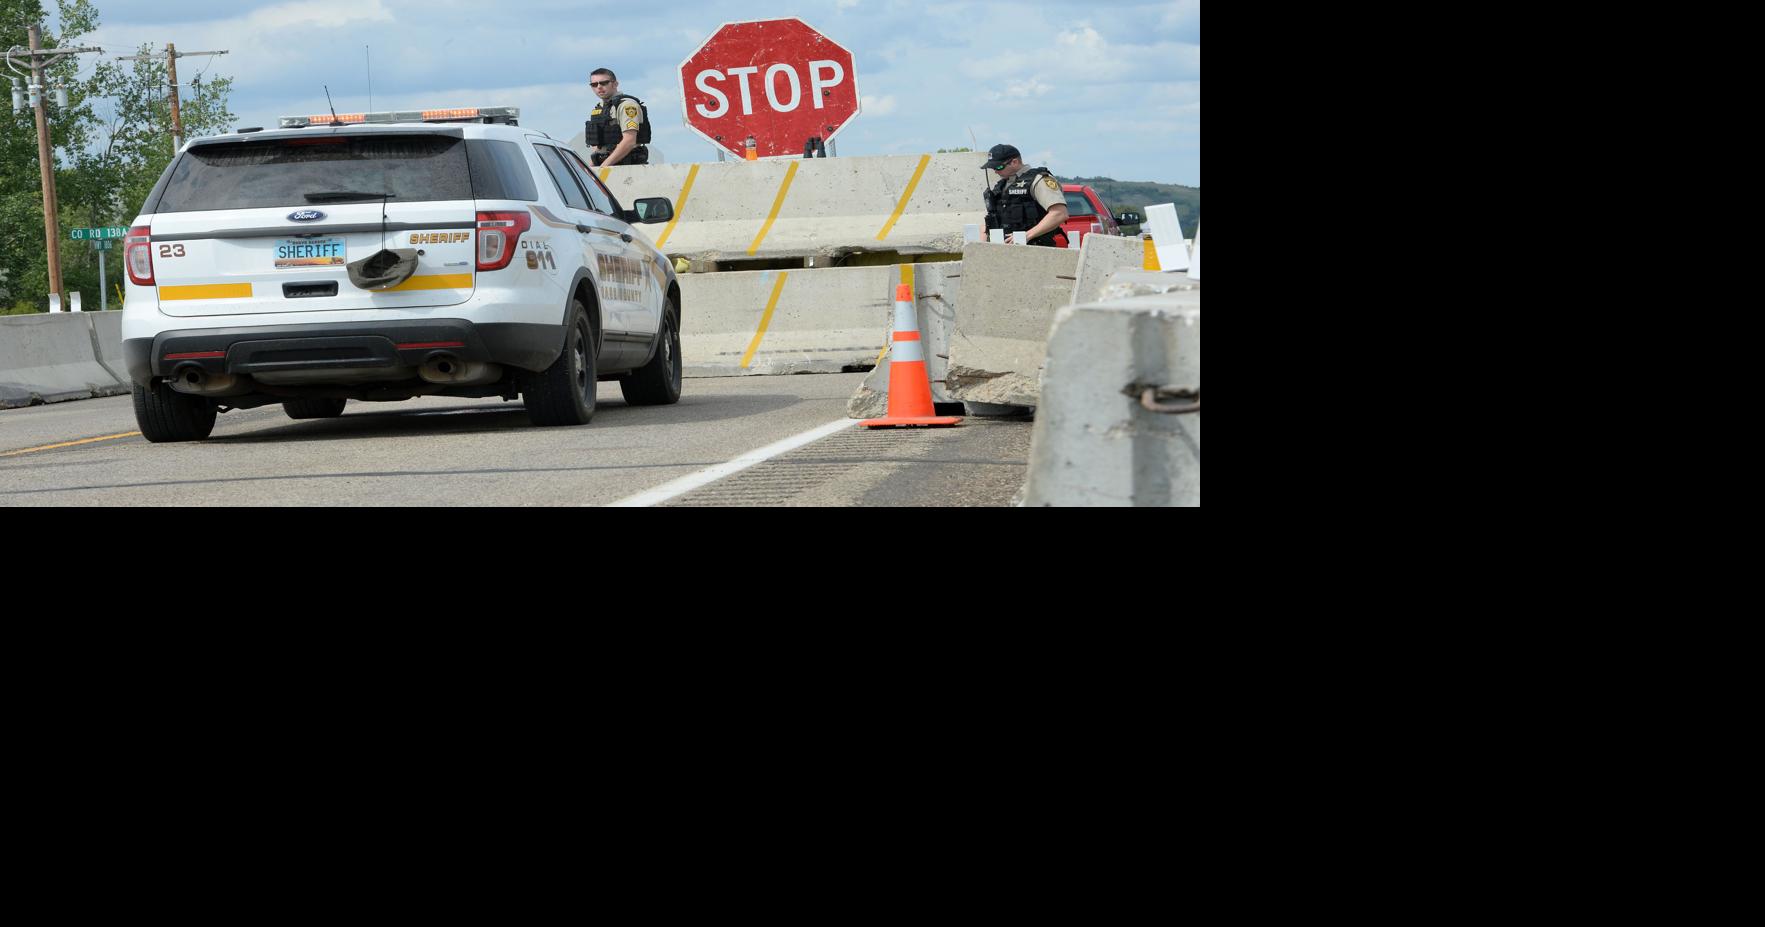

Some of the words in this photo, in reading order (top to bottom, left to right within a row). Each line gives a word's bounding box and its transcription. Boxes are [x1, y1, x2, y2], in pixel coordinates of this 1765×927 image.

[694, 59, 845, 119] STOP
[71, 229, 83, 239] CO
[89, 228, 101, 238] RD
[107, 227, 127, 237] 138A
[409, 231, 471, 245] SHERIFF
[159, 243, 186, 259] 23
[278, 243, 341, 259] SHERIFF
[520, 240, 549, 250] DIAL
[525, 249, 557, 270] 911
